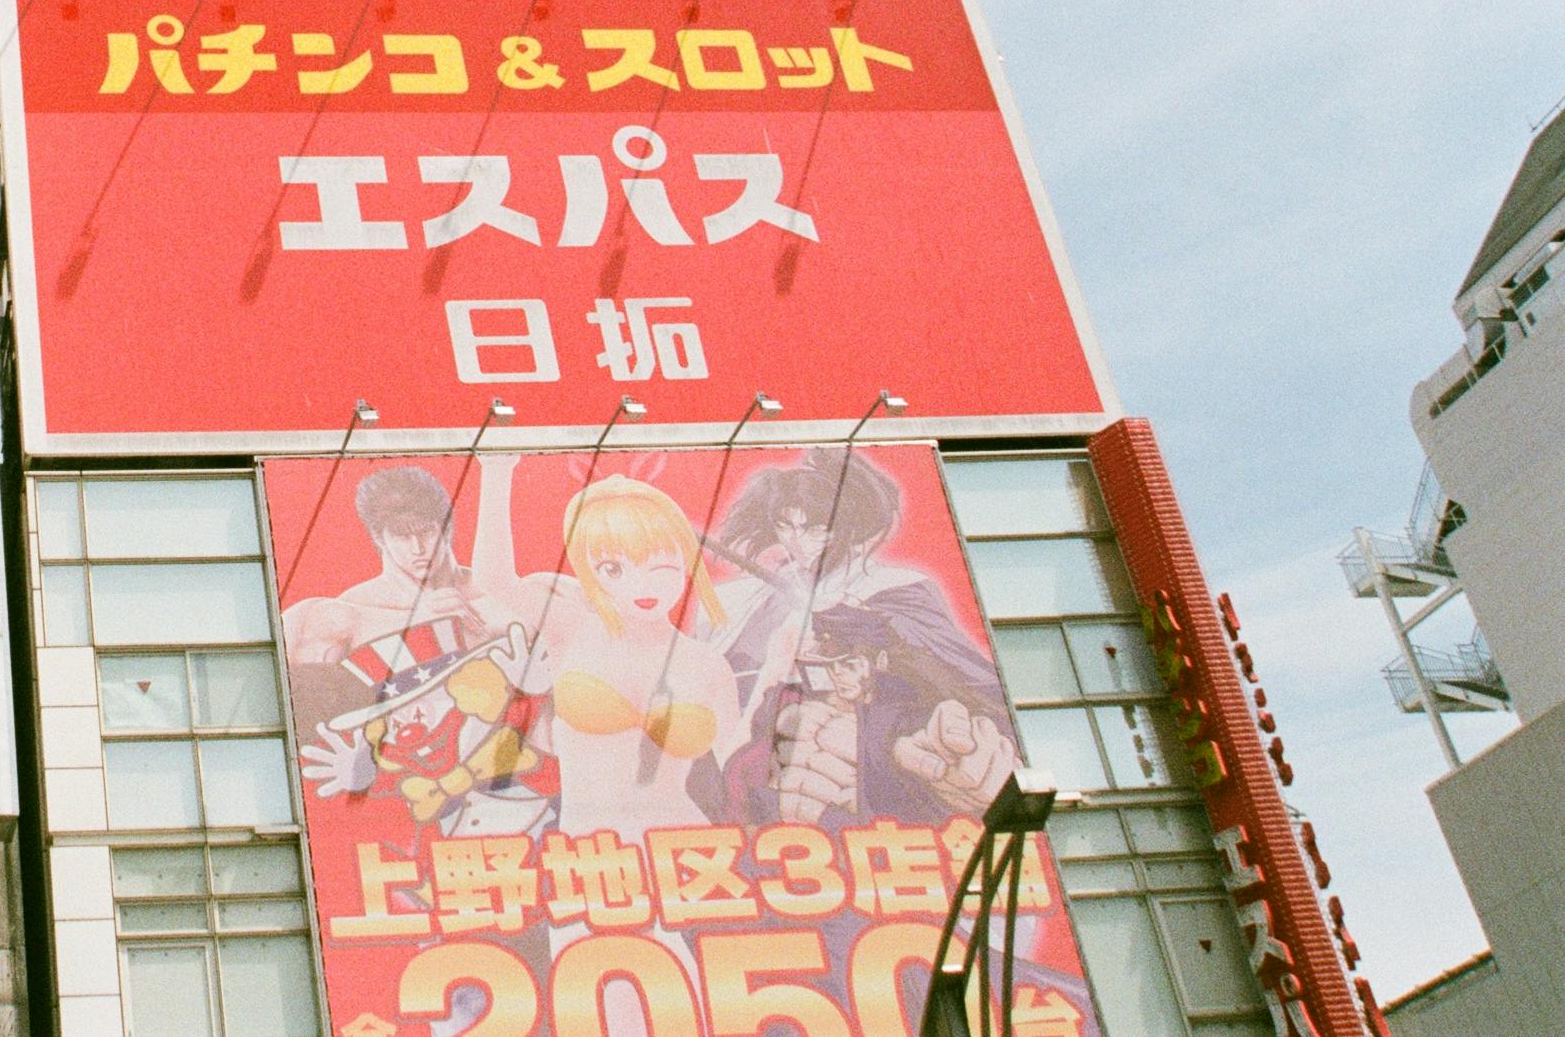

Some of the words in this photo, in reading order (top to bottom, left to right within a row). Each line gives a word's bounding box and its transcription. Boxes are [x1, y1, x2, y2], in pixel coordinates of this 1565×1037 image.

[278, 125, 821, 251] エスパス
[445, 297, 710, 383] 日拓
